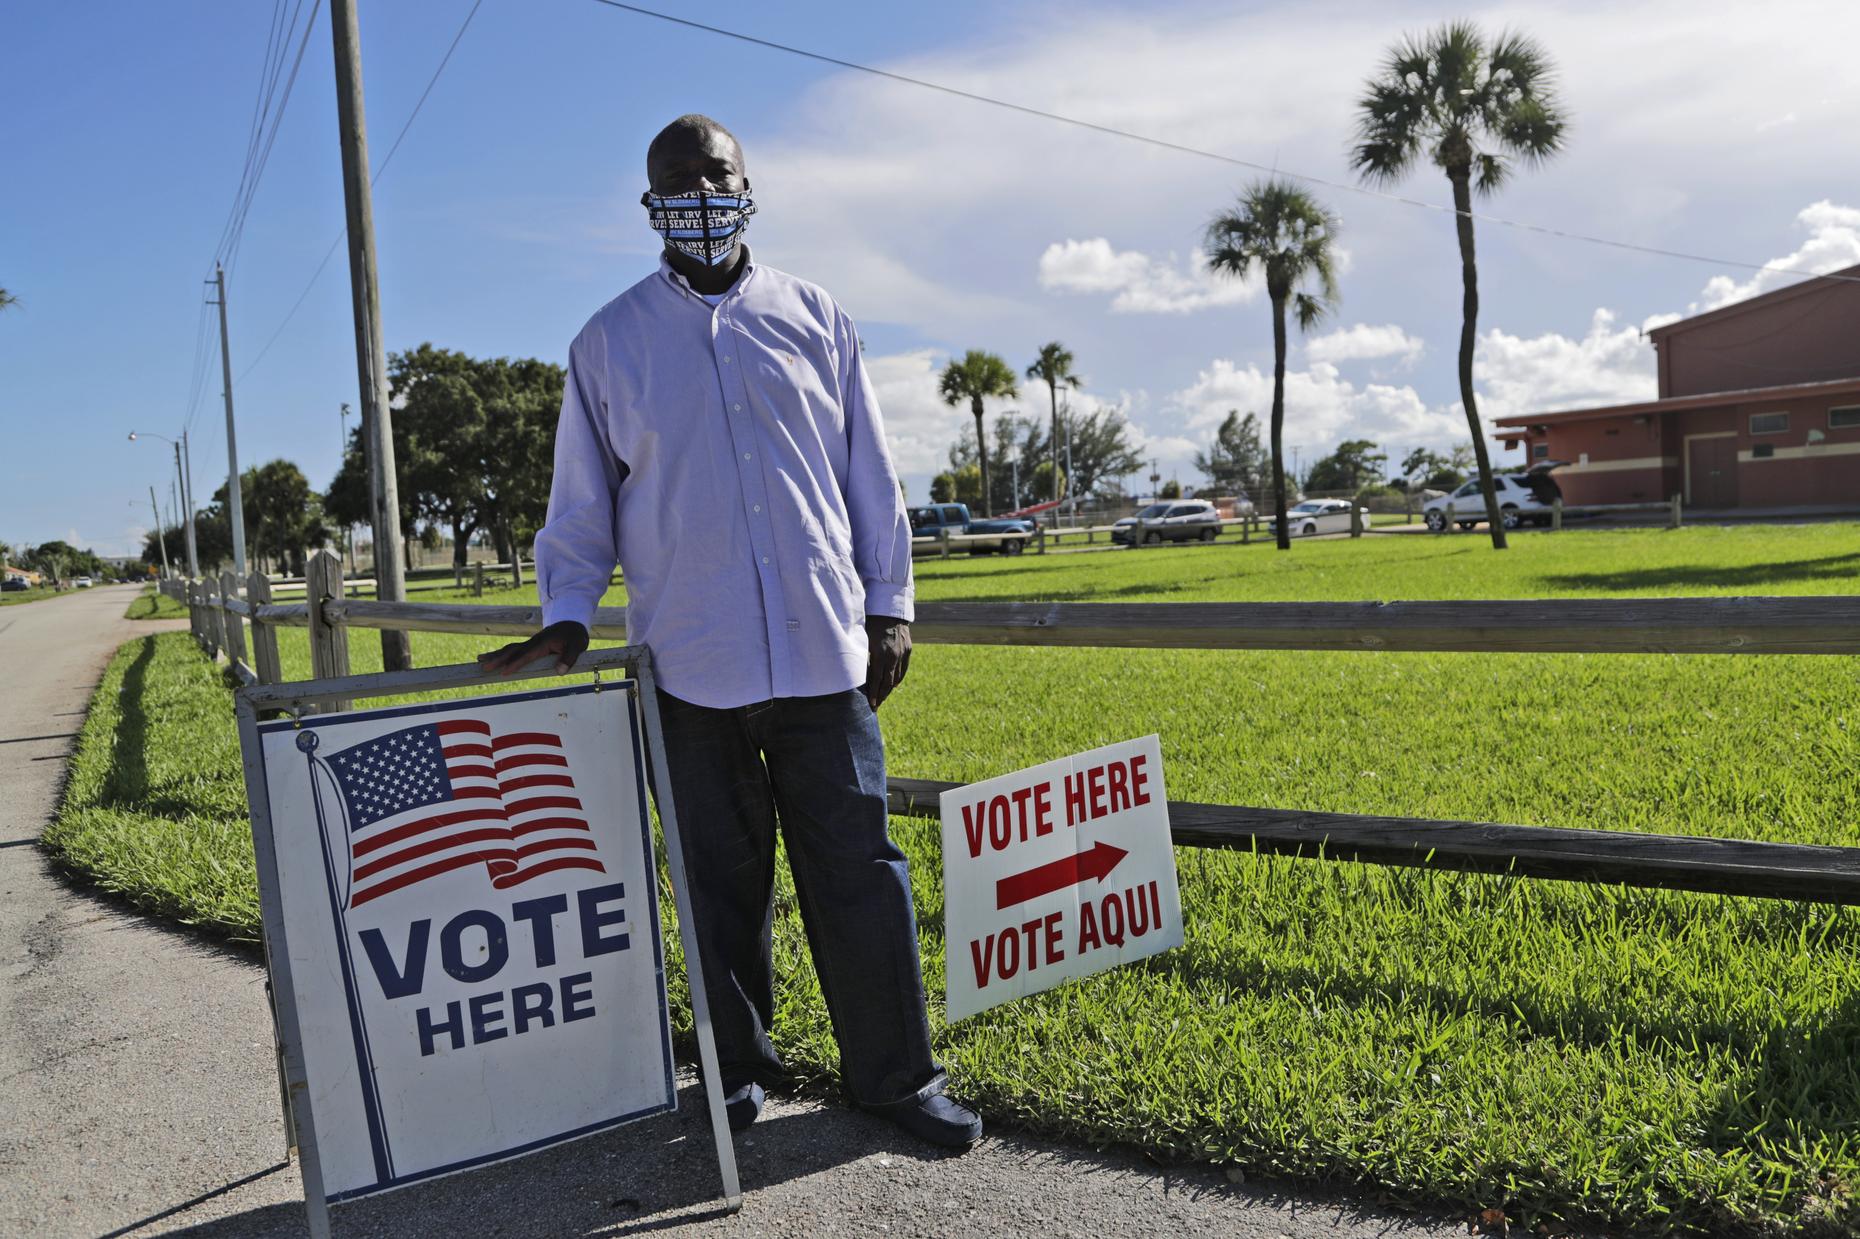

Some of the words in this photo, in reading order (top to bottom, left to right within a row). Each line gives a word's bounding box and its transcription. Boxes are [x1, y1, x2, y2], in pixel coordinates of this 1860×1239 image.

[666, 210, 679, 219] LET
[684, 210, 702, 219] IRV
[668, 218, 703, 229] SERVE!
[706, 209, 722, 218] LET
[709, 239, 723, 249] LET
[961, 782, 1053, 858] VOTE
[1064, 754, 1151, 827] HERE
[358, 882, 631, 1000] VOTE
[970, 911, 1065, 989] VOTE
[1078, 880, 1162, 955] AQUI
[416, 972, 596, 1057] HERE
